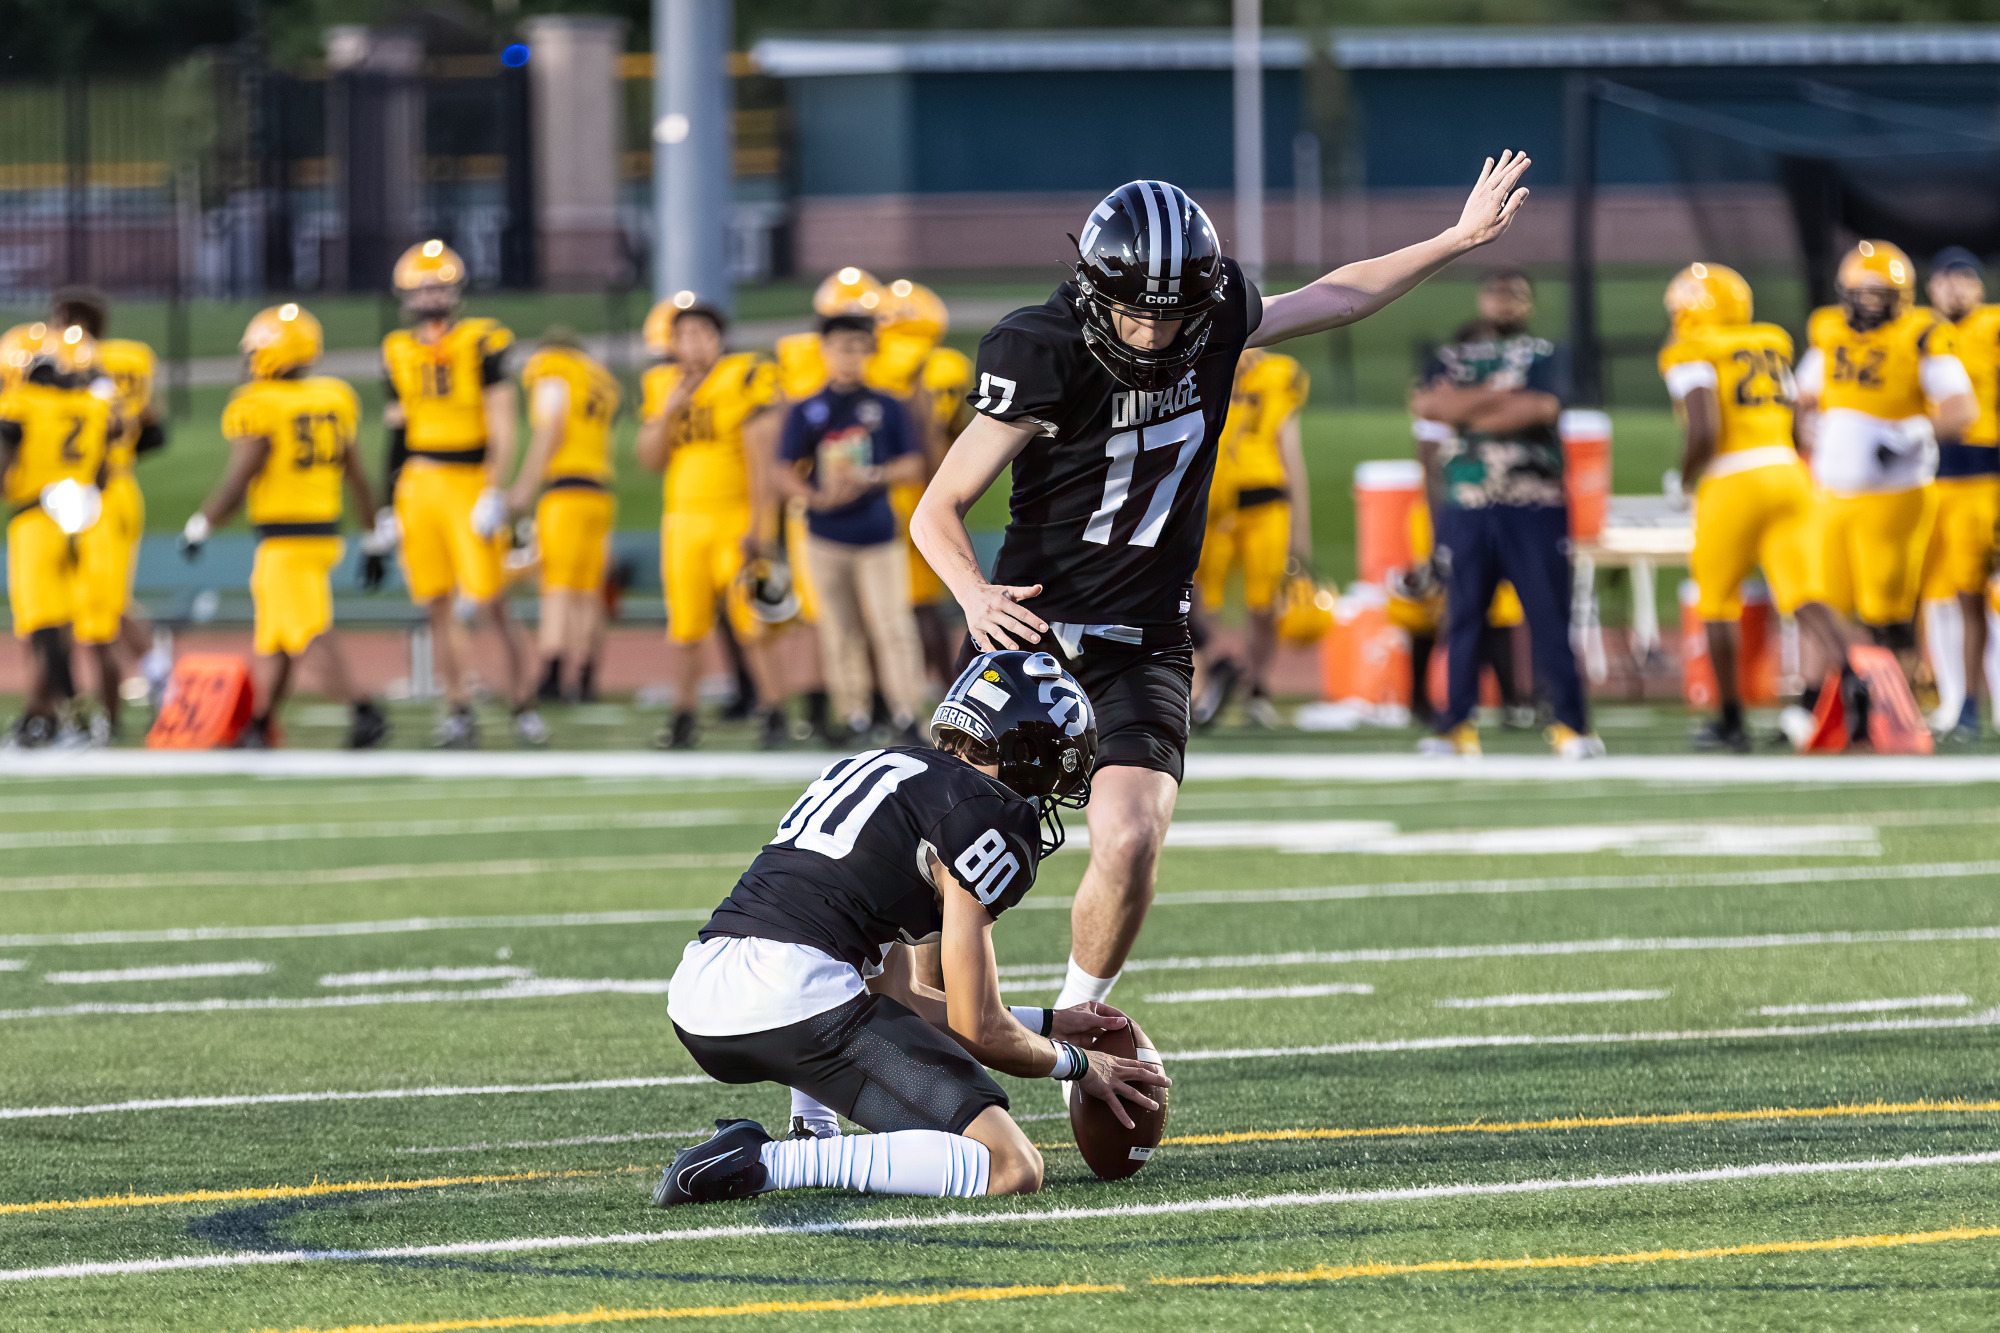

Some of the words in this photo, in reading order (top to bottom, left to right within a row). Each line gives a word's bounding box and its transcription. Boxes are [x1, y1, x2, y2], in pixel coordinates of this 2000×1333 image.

[1145, 295, 1178, 304] COD
[974, 372, 1017, 415] 17
[1111, 368, 1201, 428] DUPAGE
[1082, 409, 1205, 548] 17
[769, 749, 929, 860] 80
[954, 828, 1020, 905] 80
